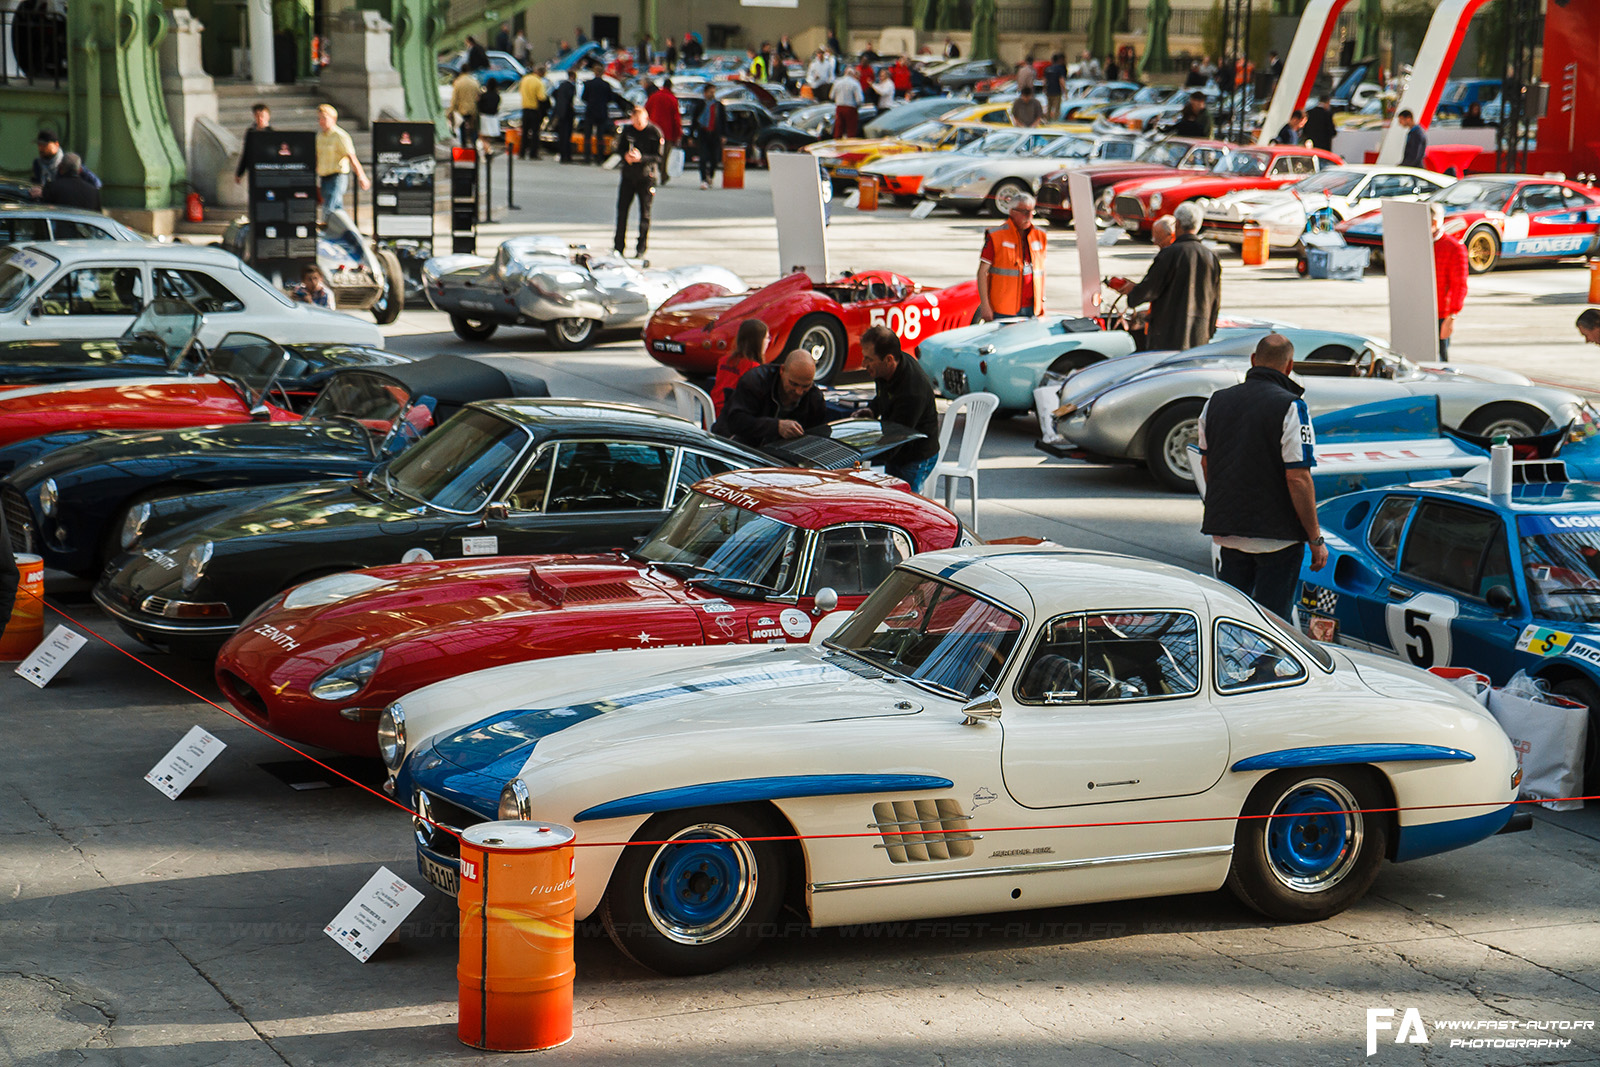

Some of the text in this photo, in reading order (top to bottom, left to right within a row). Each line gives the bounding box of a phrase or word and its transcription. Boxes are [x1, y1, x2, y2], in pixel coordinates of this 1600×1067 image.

[1515, 238, 1583, 254] PIONEER
[870, 305, 921, 340] 508
[705, 484, 760, 509] ZENITH
[143, 548, 179, 571] ZENITH
[254, 624, 301, 652] ZENITH
[752, 628, 784, 639] MOTUL
[1404, 608, 1434, 670] 5
[1541, 633, 1558, 652] S
